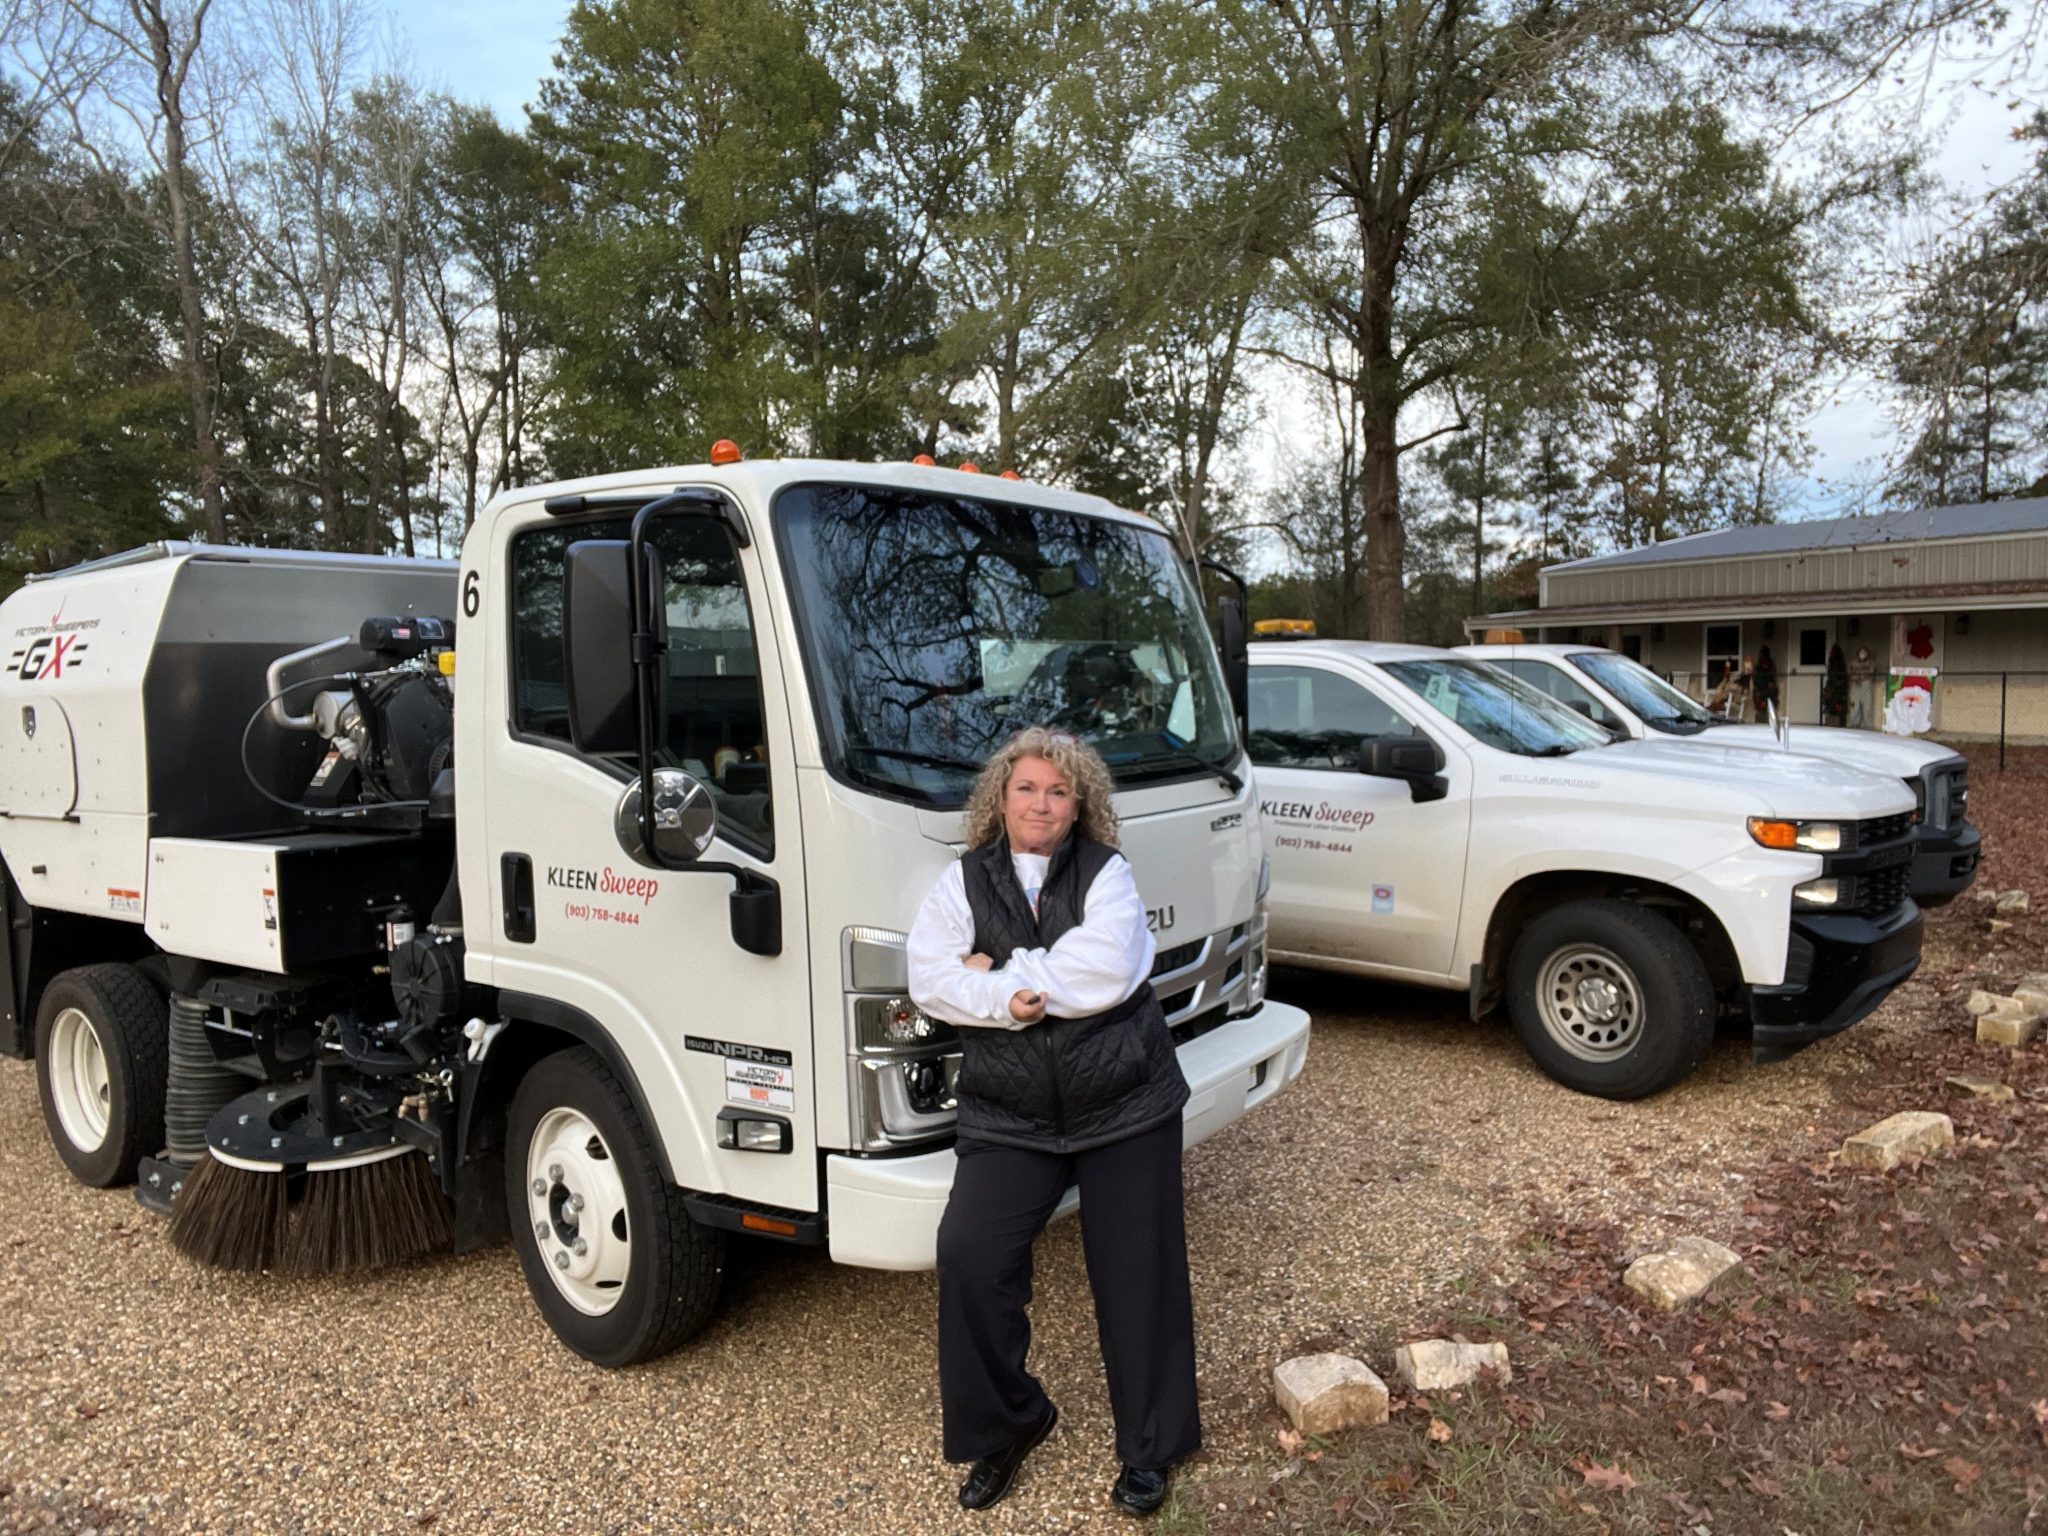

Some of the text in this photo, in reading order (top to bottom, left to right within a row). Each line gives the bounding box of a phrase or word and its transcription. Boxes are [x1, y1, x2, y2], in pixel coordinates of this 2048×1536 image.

[463, 569, 480, 618] 6
[1430, 680, 1440, 698] 3
[1260, 800, 1375, 831] KLEEN Sweep
[547, 866, 658, 906] KLEEN Sweep
[565, 902, 640, 925] (903) 758-4844
[686, 1039, 712, 1051] ISUZU
[713, 1040, 763, 1060] NPR
